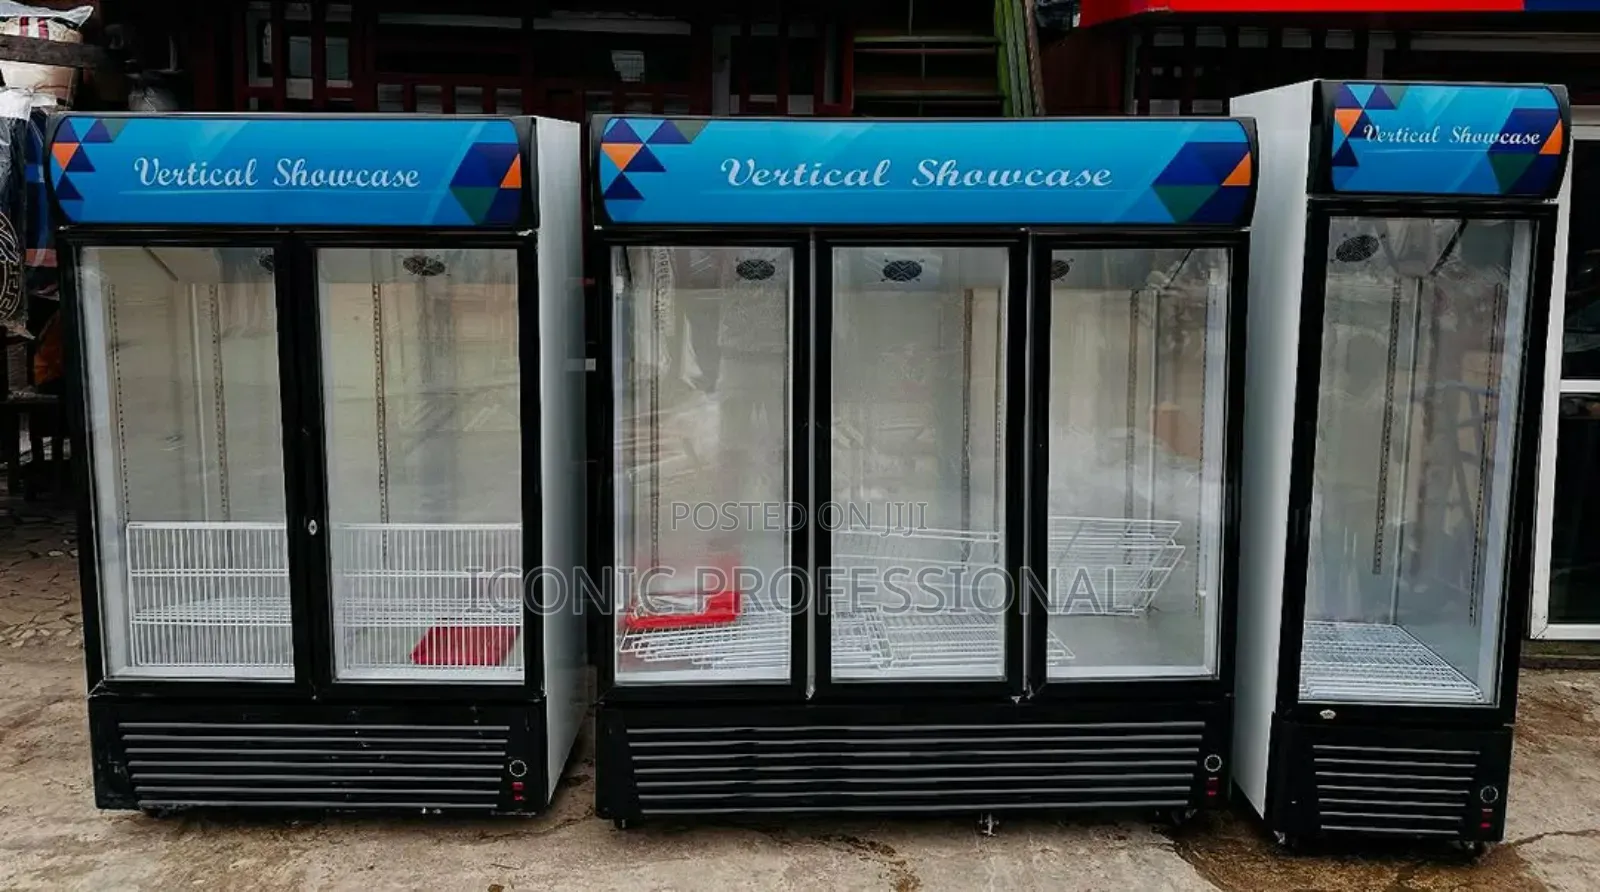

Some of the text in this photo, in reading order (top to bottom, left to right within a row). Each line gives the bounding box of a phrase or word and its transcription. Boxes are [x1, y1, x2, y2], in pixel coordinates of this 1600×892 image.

[1363, 124, 1541, 145] Vertical Showcase
[134, 157, 420, 188] Vertical Showcase
[720, 158, 1113, 187] Vertical Showcase
